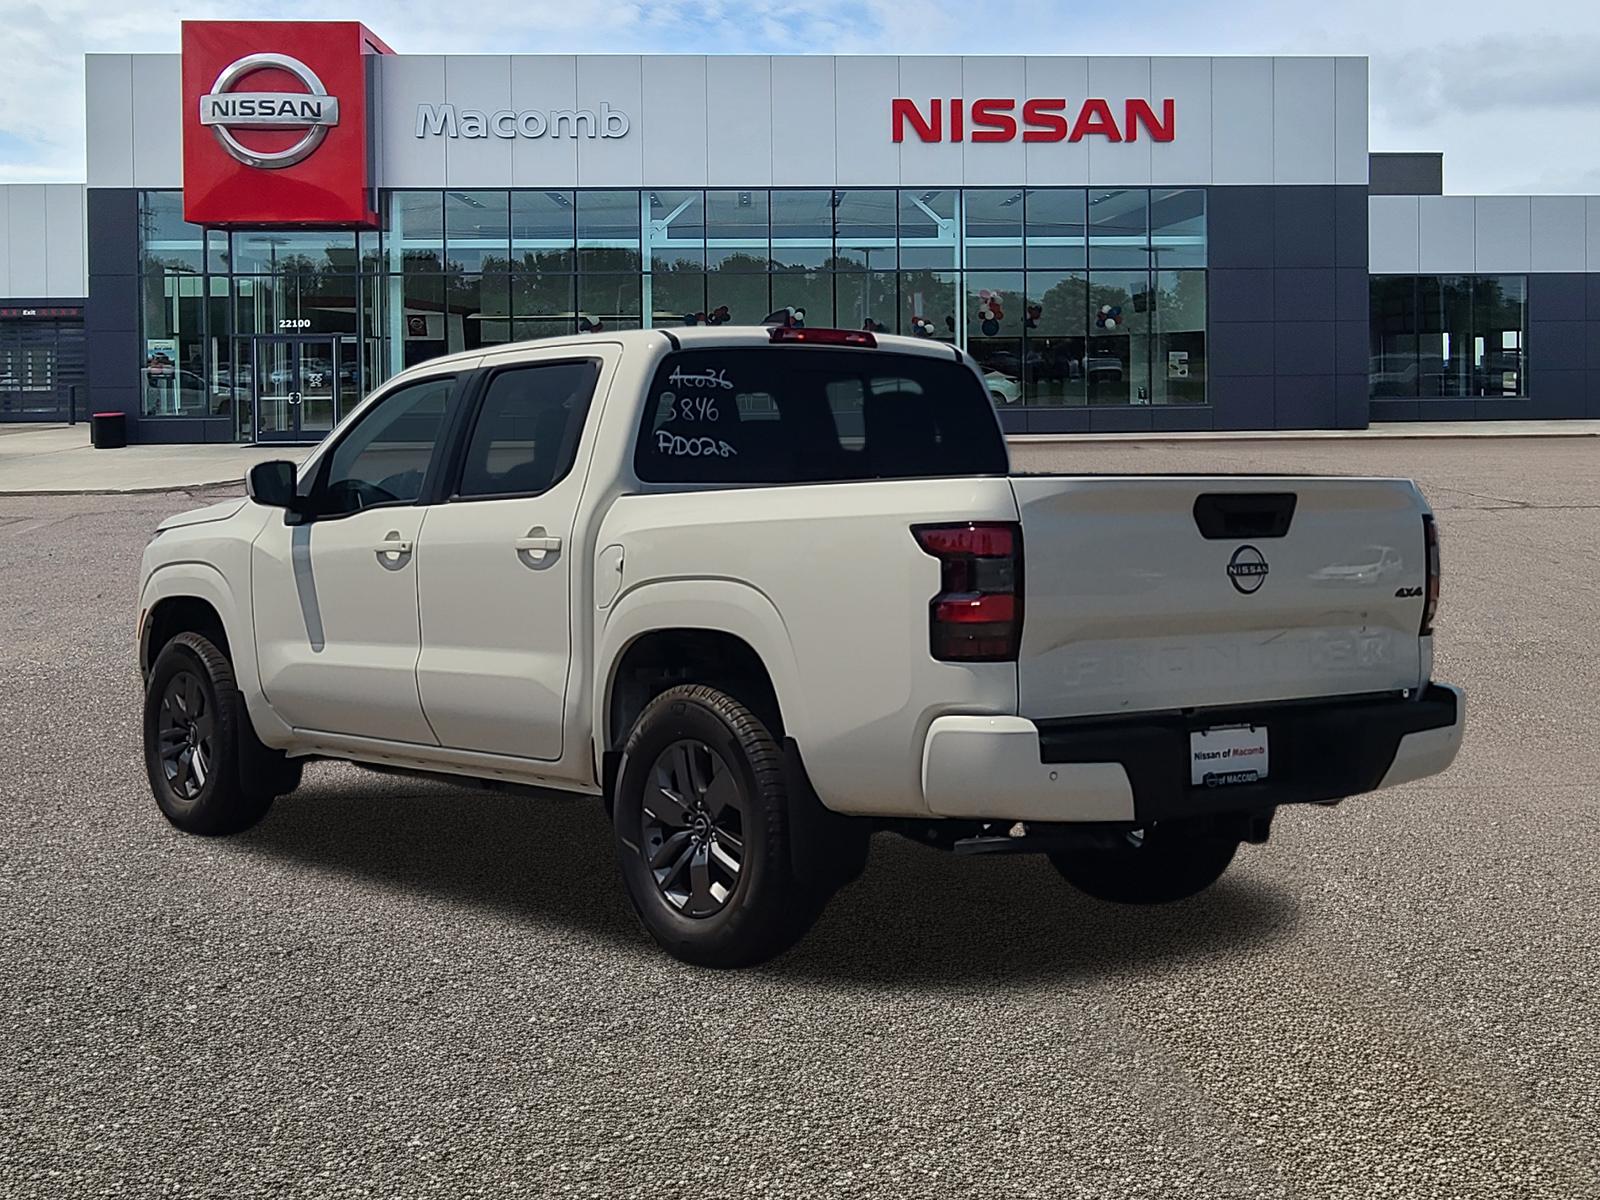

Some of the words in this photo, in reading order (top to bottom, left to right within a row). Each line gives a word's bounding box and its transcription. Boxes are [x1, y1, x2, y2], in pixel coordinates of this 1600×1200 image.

[211, 98, 322, 118] NISSAN
[414, 102, 631, 139] Macomb
[892, 98, 1175, 143] NISSAN
[279, 319, 311, 328] 22100
[1228, 564, 1268, 575] NISSAN
[1194, 751, 1221, 761] Nissan
[1222, 748, 1231, 758] of
[1232, 746, 1265, 757] Macomb
